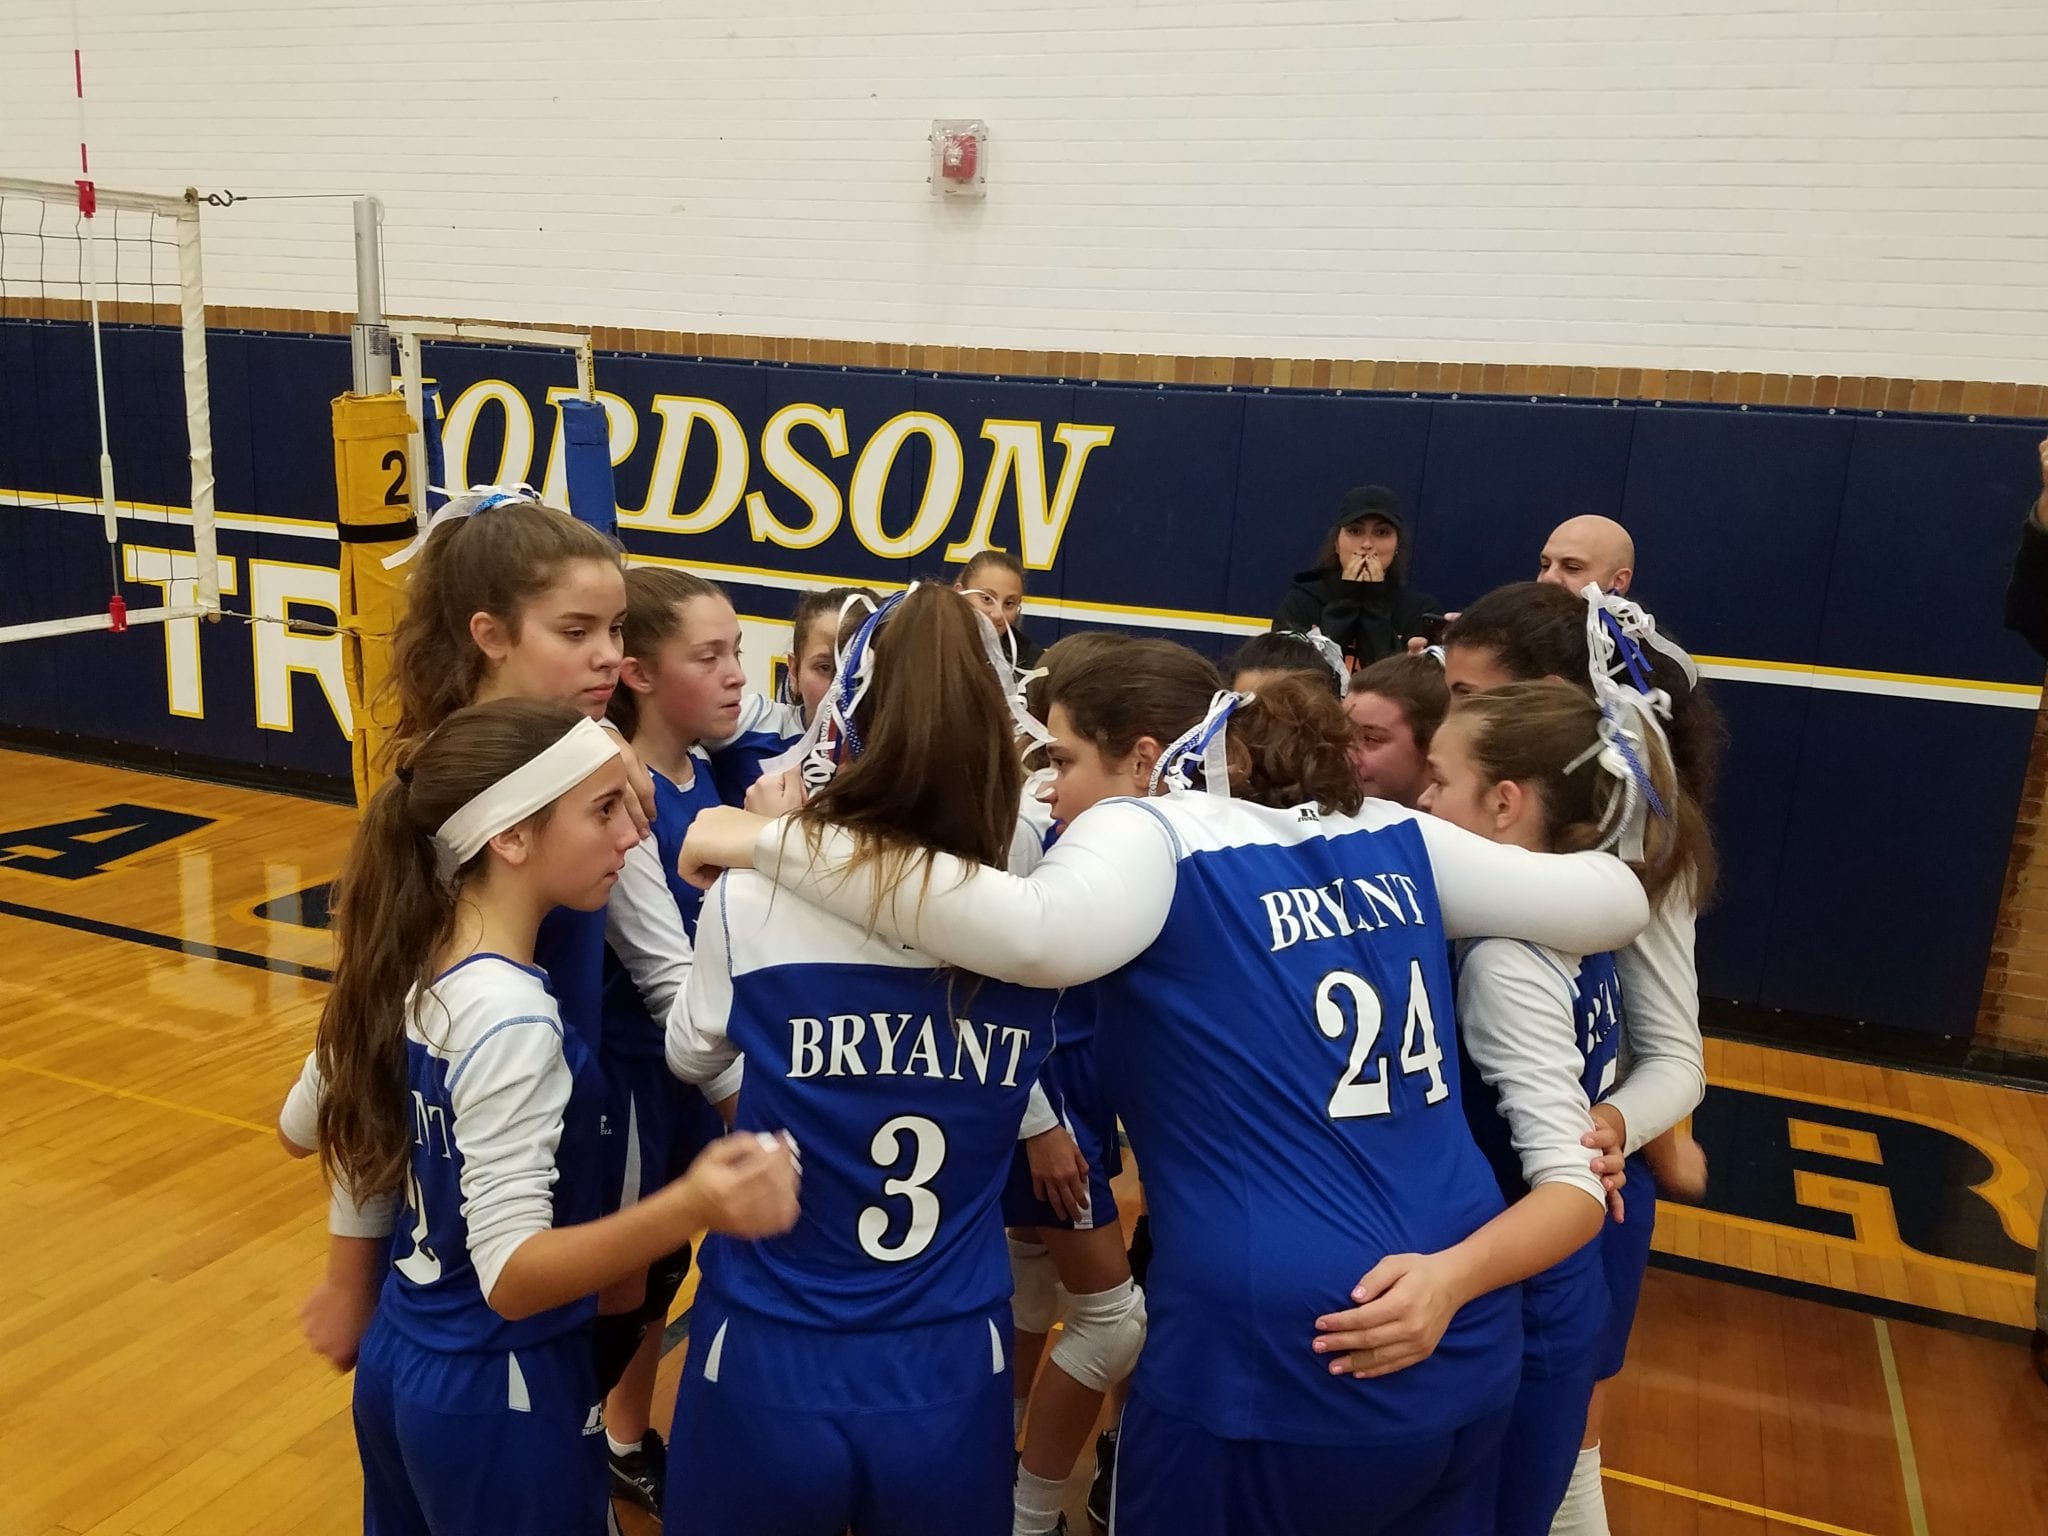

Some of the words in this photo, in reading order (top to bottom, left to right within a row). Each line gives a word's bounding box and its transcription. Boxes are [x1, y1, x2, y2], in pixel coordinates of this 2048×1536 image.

[380, 449, 411, 507] 2
[1259, 872, 1426, 952] BRYNT
[785, 1012, 1031, 1088] BRYANT
[1314, 957, 1450, 1119] 24
[857, 1115, 946, 1263] 3
